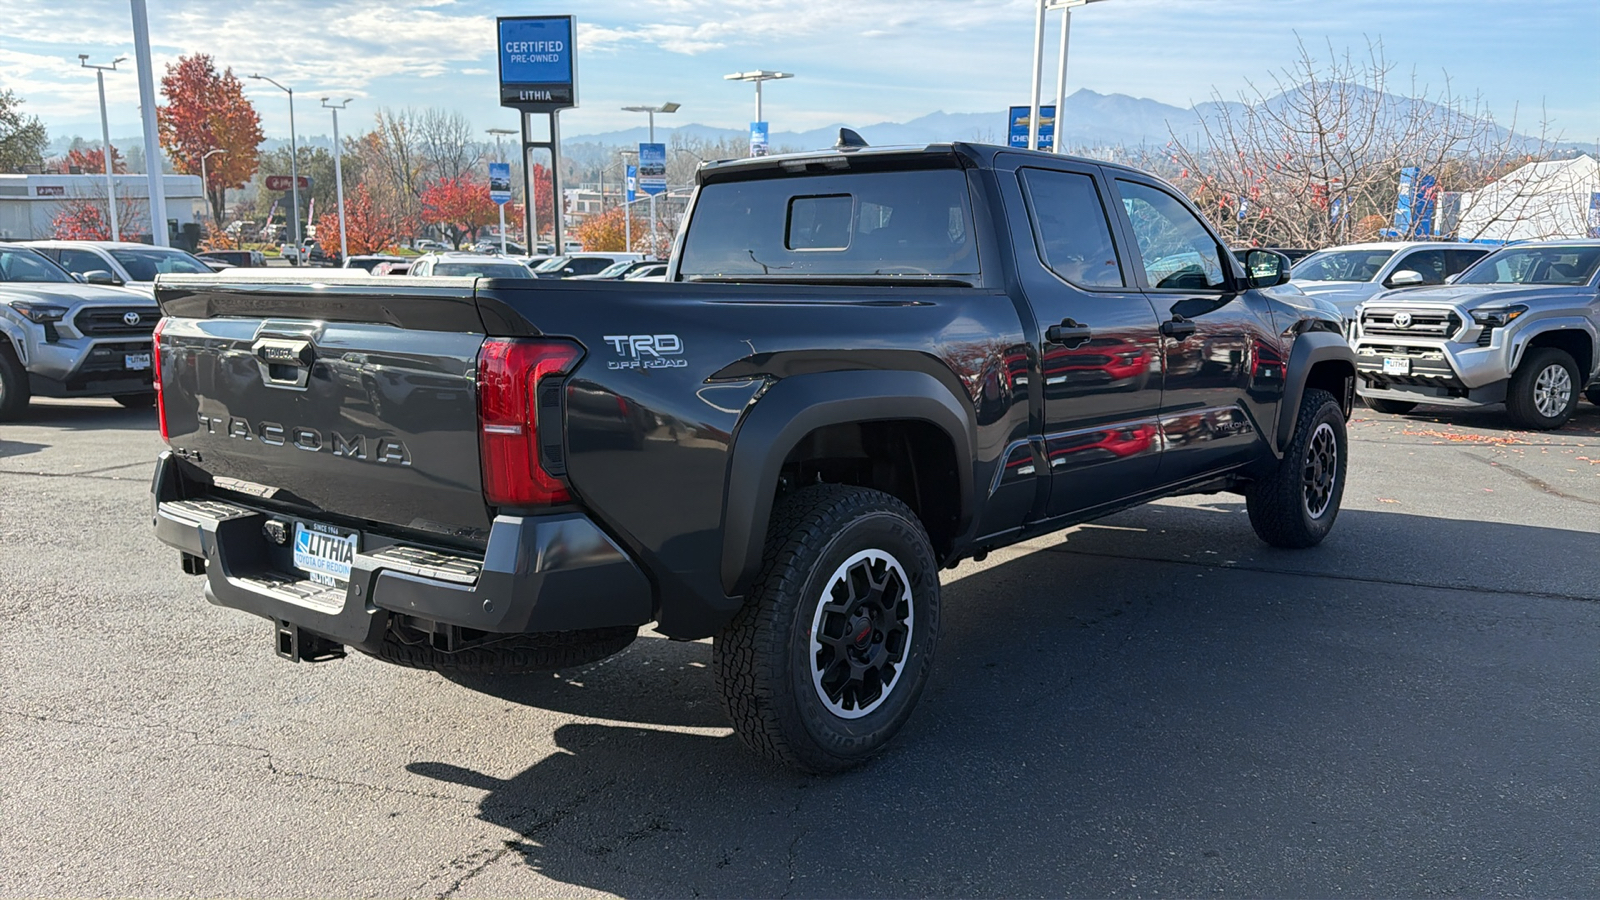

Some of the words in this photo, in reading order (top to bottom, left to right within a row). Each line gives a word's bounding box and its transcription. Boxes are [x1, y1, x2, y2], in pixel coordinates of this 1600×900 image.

[505, 40, 564, 54] CERTIFIED
[510, 53, 559, 64] PRE-OWNED
[519, 90, 552, 101] LITHIA
[603, 334, 684, 360] TRD
[607, 359, 640, 370] OFF
[643, 358, 688, 369] ROAD
[199, 413, 411, 466] TACOMA
[313, 523, 327, 532] SINCE
[308, 533, 354, 565] LITHIA
[296, 552, 317, 567] TOYOTA
[317, 558, 326, 569] OF
[326, 560, 350, 575] REDDIN
